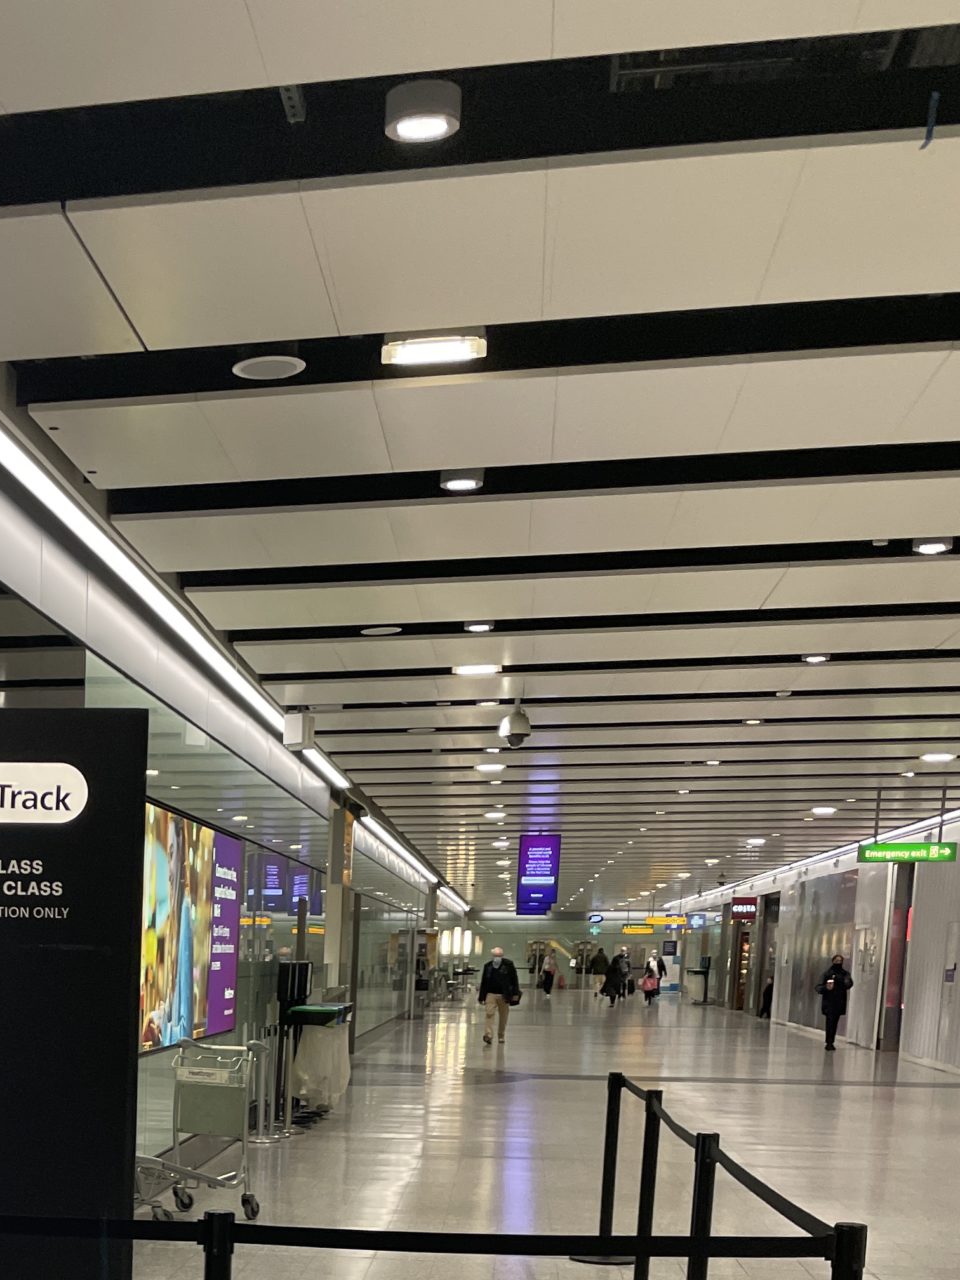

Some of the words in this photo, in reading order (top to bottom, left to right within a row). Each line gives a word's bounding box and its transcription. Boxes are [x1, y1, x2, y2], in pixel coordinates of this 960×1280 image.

[865, 849, 910, 859] Emergency
[910, 848, 927, 858] exit
[2, 881, 64, 896] CLASS
[33, 906, 70, 919] ONLY
